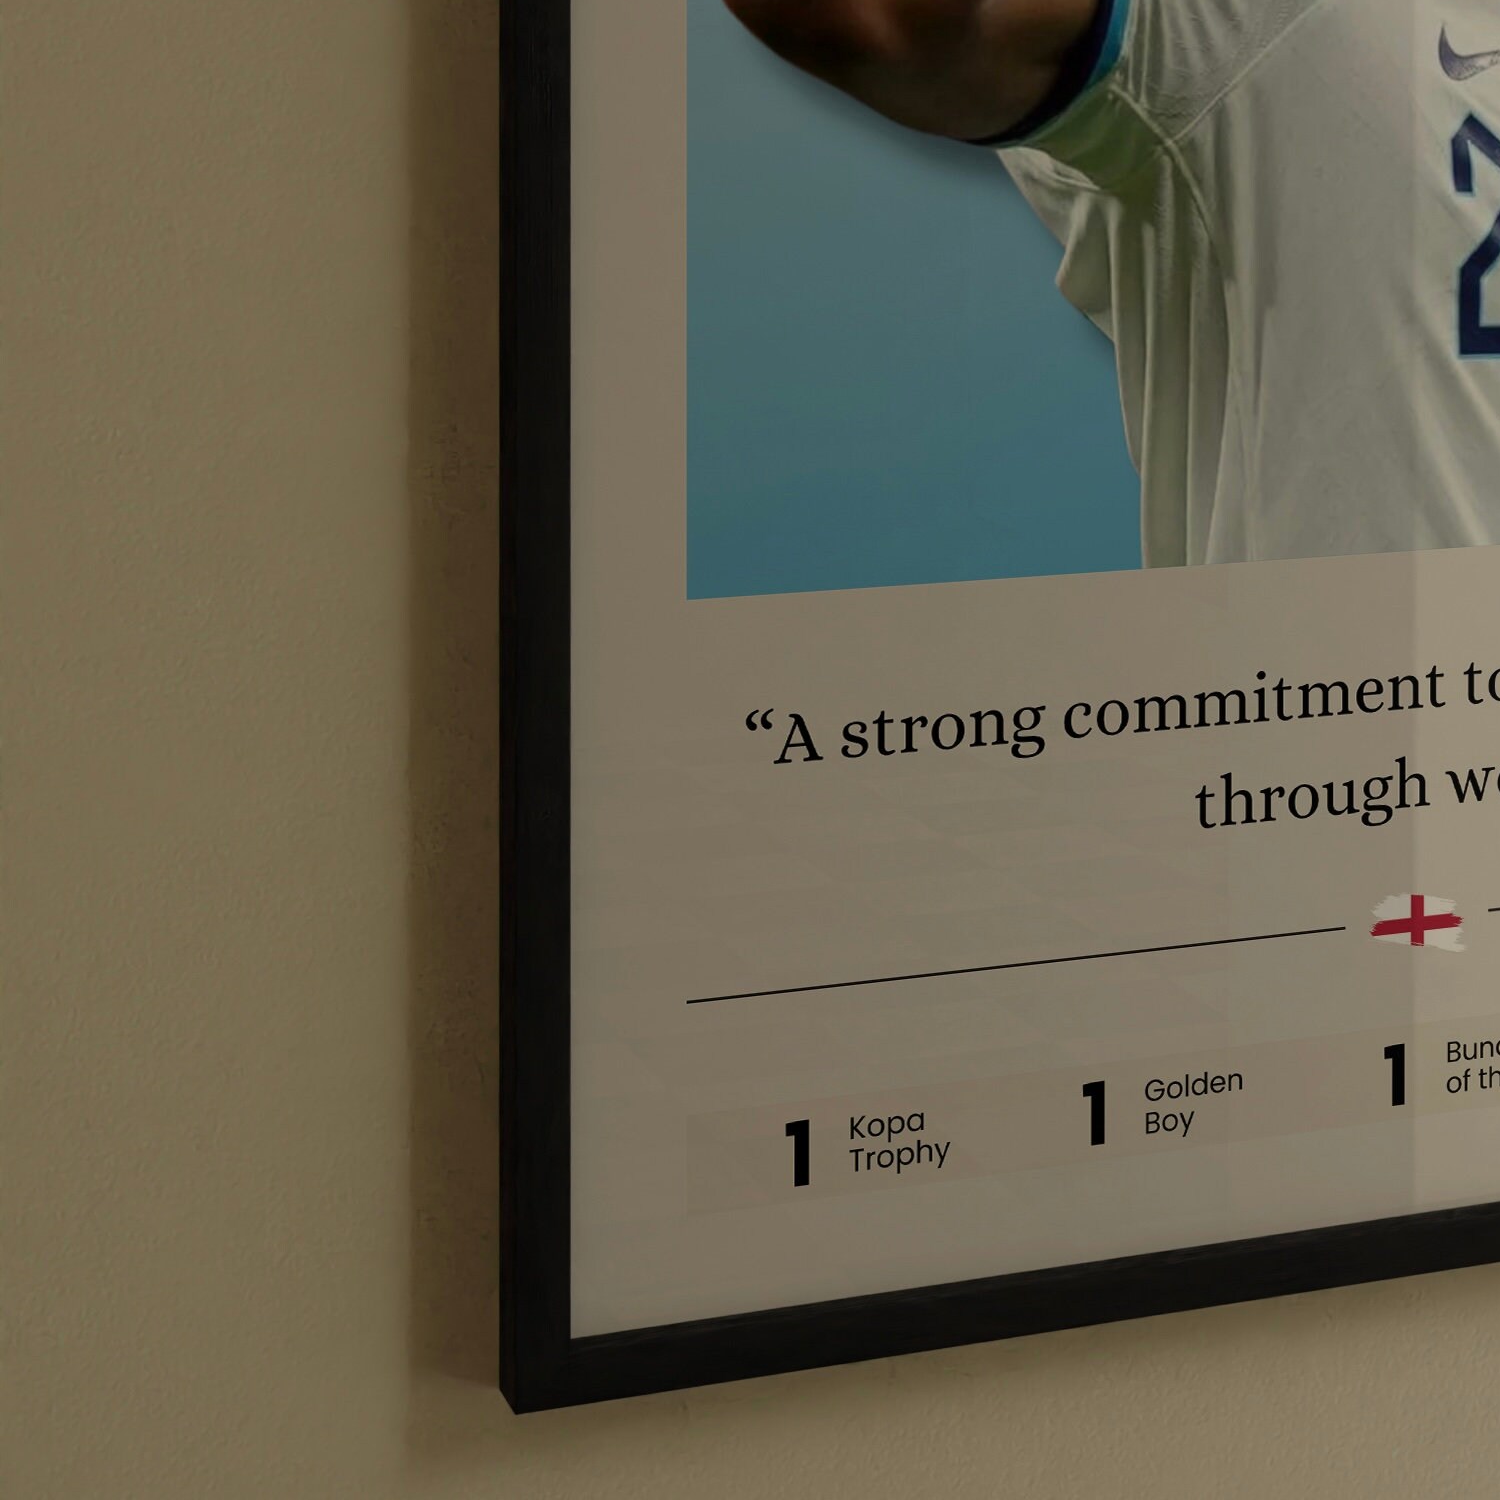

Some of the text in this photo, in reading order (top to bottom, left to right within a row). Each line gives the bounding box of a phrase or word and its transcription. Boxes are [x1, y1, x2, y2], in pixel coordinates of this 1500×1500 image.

[745, 707, 824, 765] “A
[840, 705, 1047, 759] strong
[1063, 665, 1446, 739] commitment
[1194, 755, 1431, 829] through
[1144, 1071, 1243, 1102] Golden
[1383, 1043, 1406, 1107] 1
[1446, 1068, 1471, 1094] of
[850, 1112, 925, 1143] Kopa
[1082, 1080, 1106, 1146] 1
[1145, 1110, 1195, 1138] Boy
[785, 1119, 810, 1188] 1
[849, 1139, 951, 1175] Trophy
